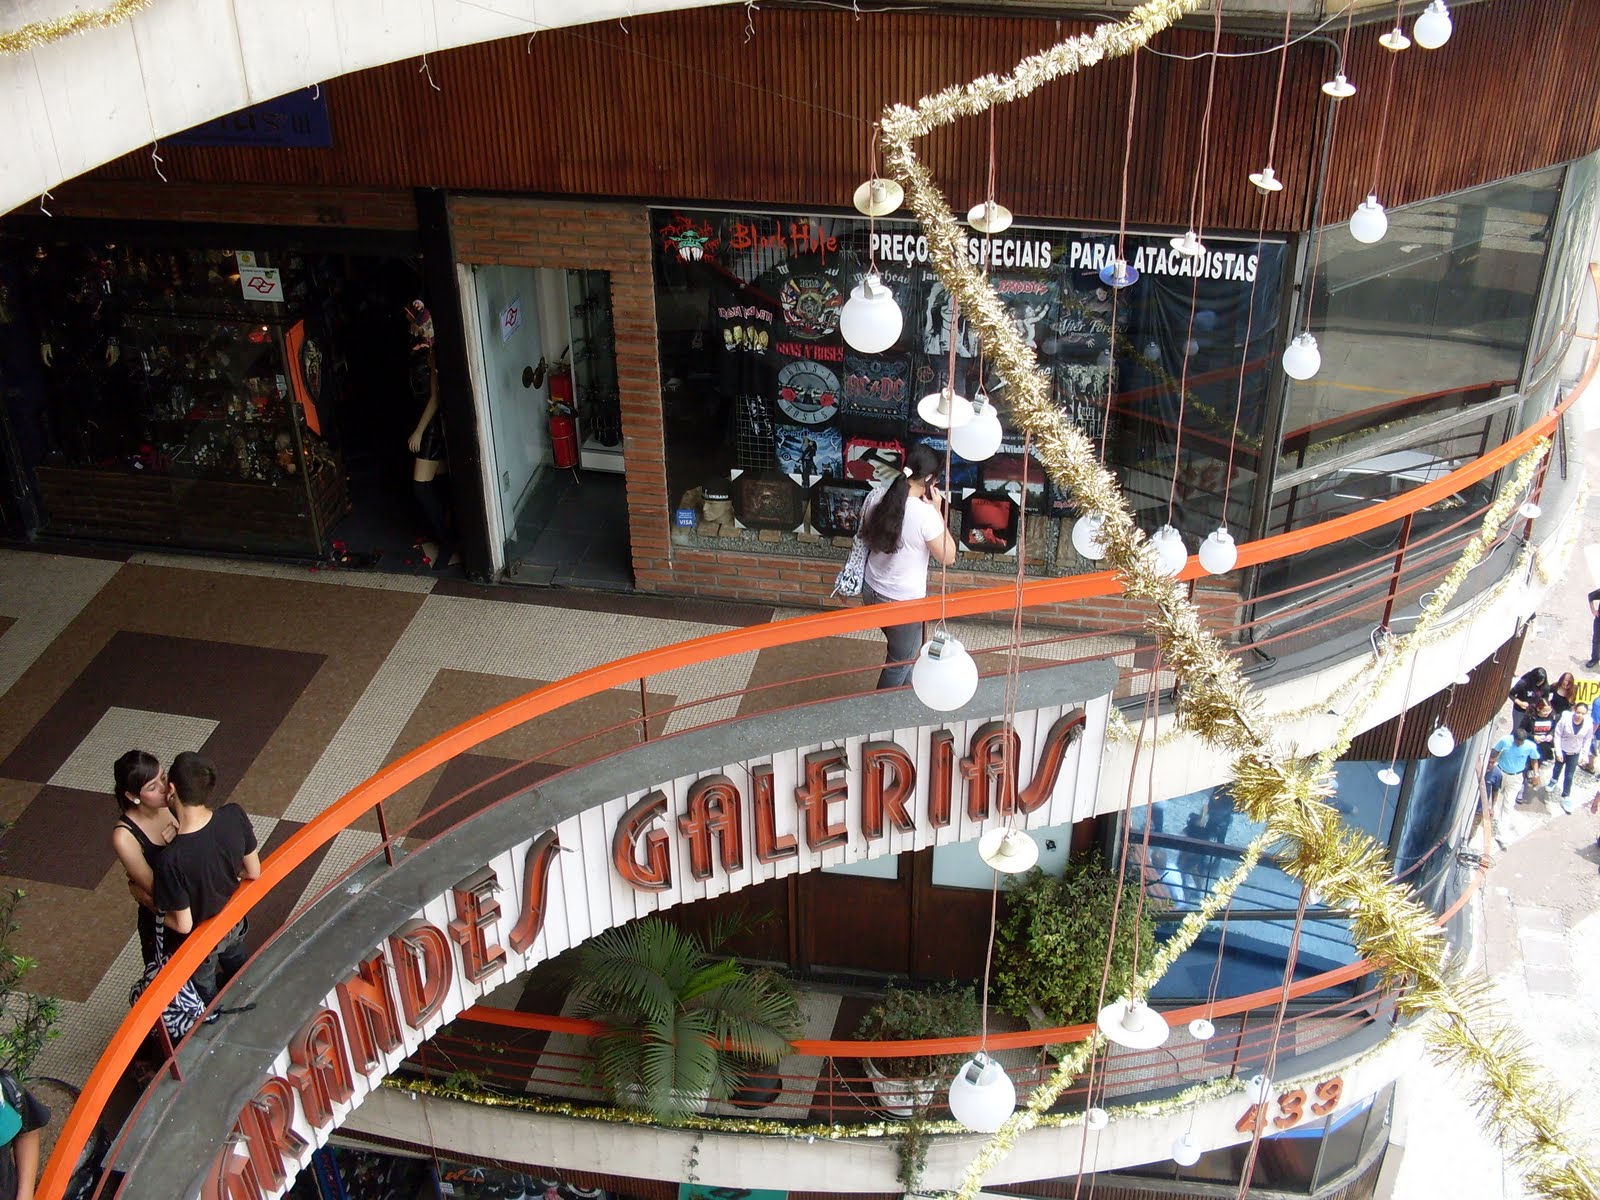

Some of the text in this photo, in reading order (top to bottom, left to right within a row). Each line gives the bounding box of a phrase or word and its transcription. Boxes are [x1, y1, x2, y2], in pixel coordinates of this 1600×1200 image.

[957, 238, 1051, 268] SPECIAIS
[1070, 241, 1117, 270] PARA
[1133, 246, 1258, 282] ATACADISTAS
[612, 707, 1087, 894] GALERIAS
[1235, 1076, 1344, 1134] 439
